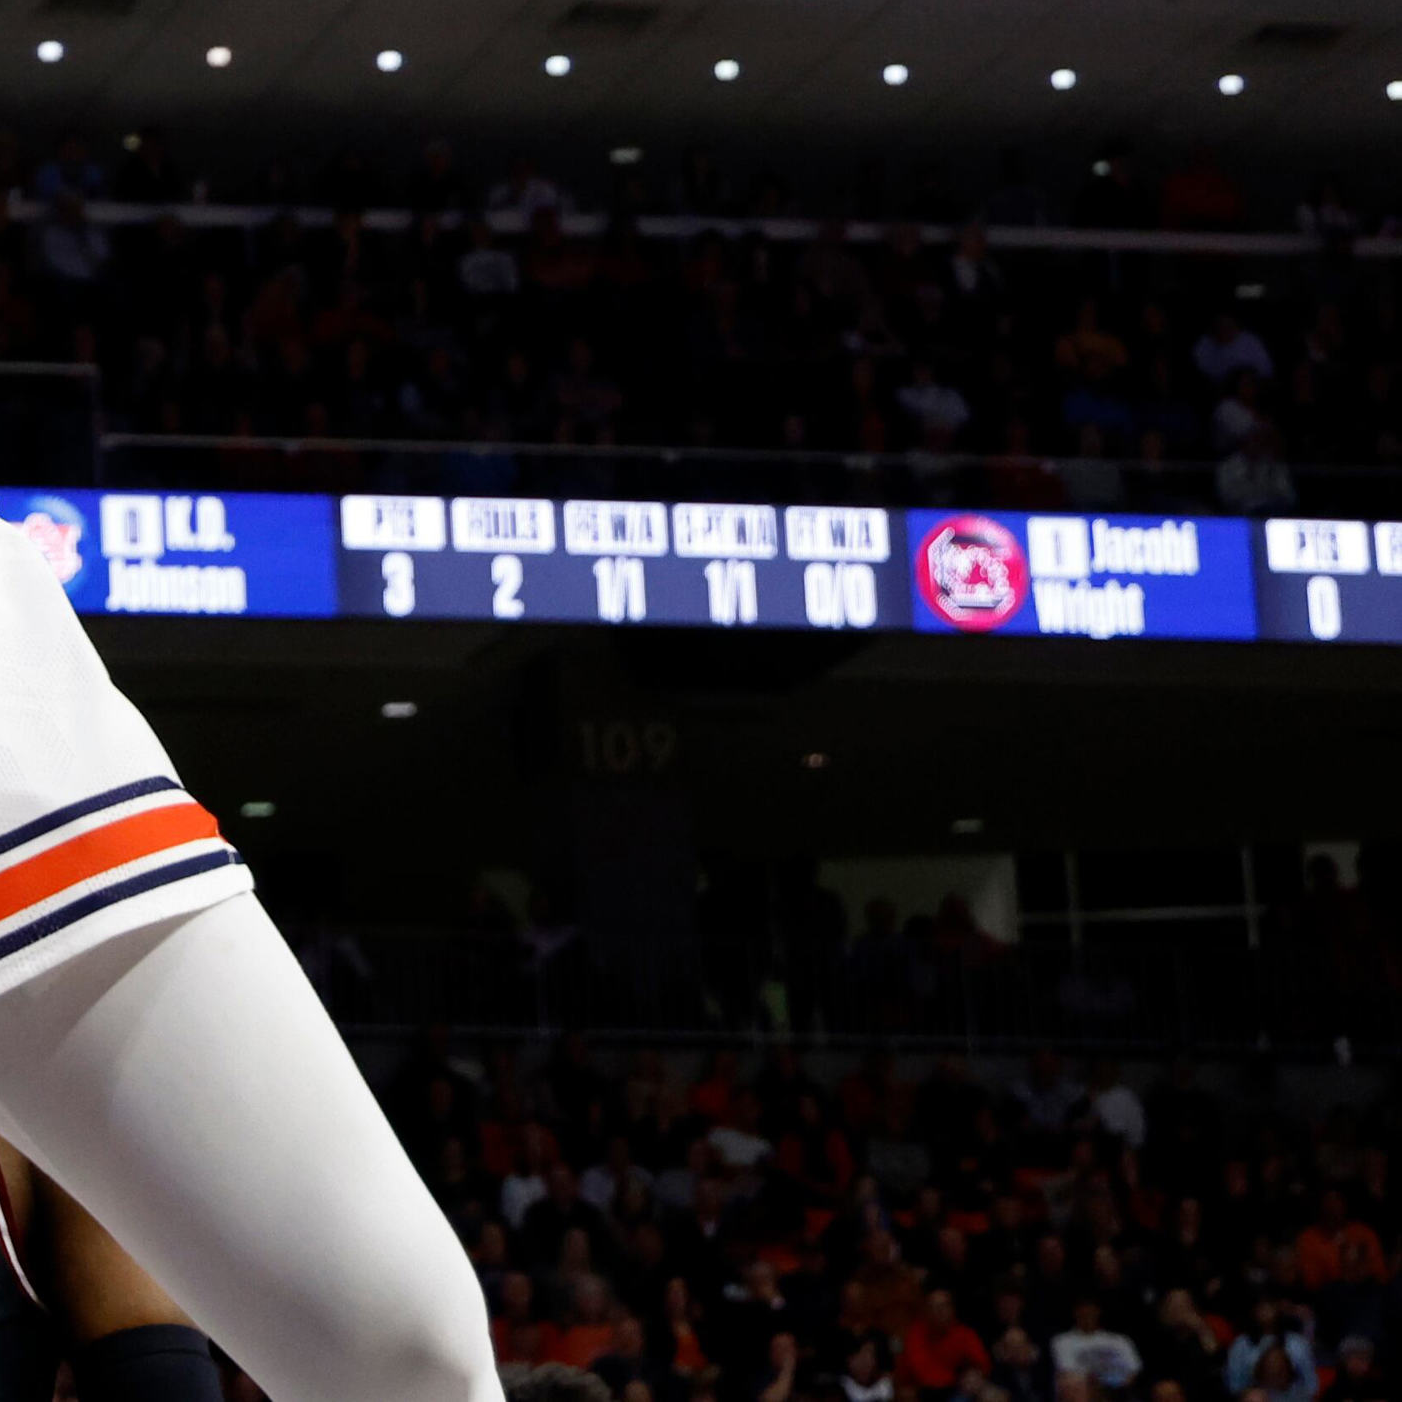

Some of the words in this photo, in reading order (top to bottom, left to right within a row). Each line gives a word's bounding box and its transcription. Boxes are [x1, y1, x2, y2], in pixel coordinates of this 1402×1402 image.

[382, 552, 415, 617] 3
[491, 554, 525, 618] 2
[1307, 575, 1342, 640] 0
[580, 720, 678, 773] 109
